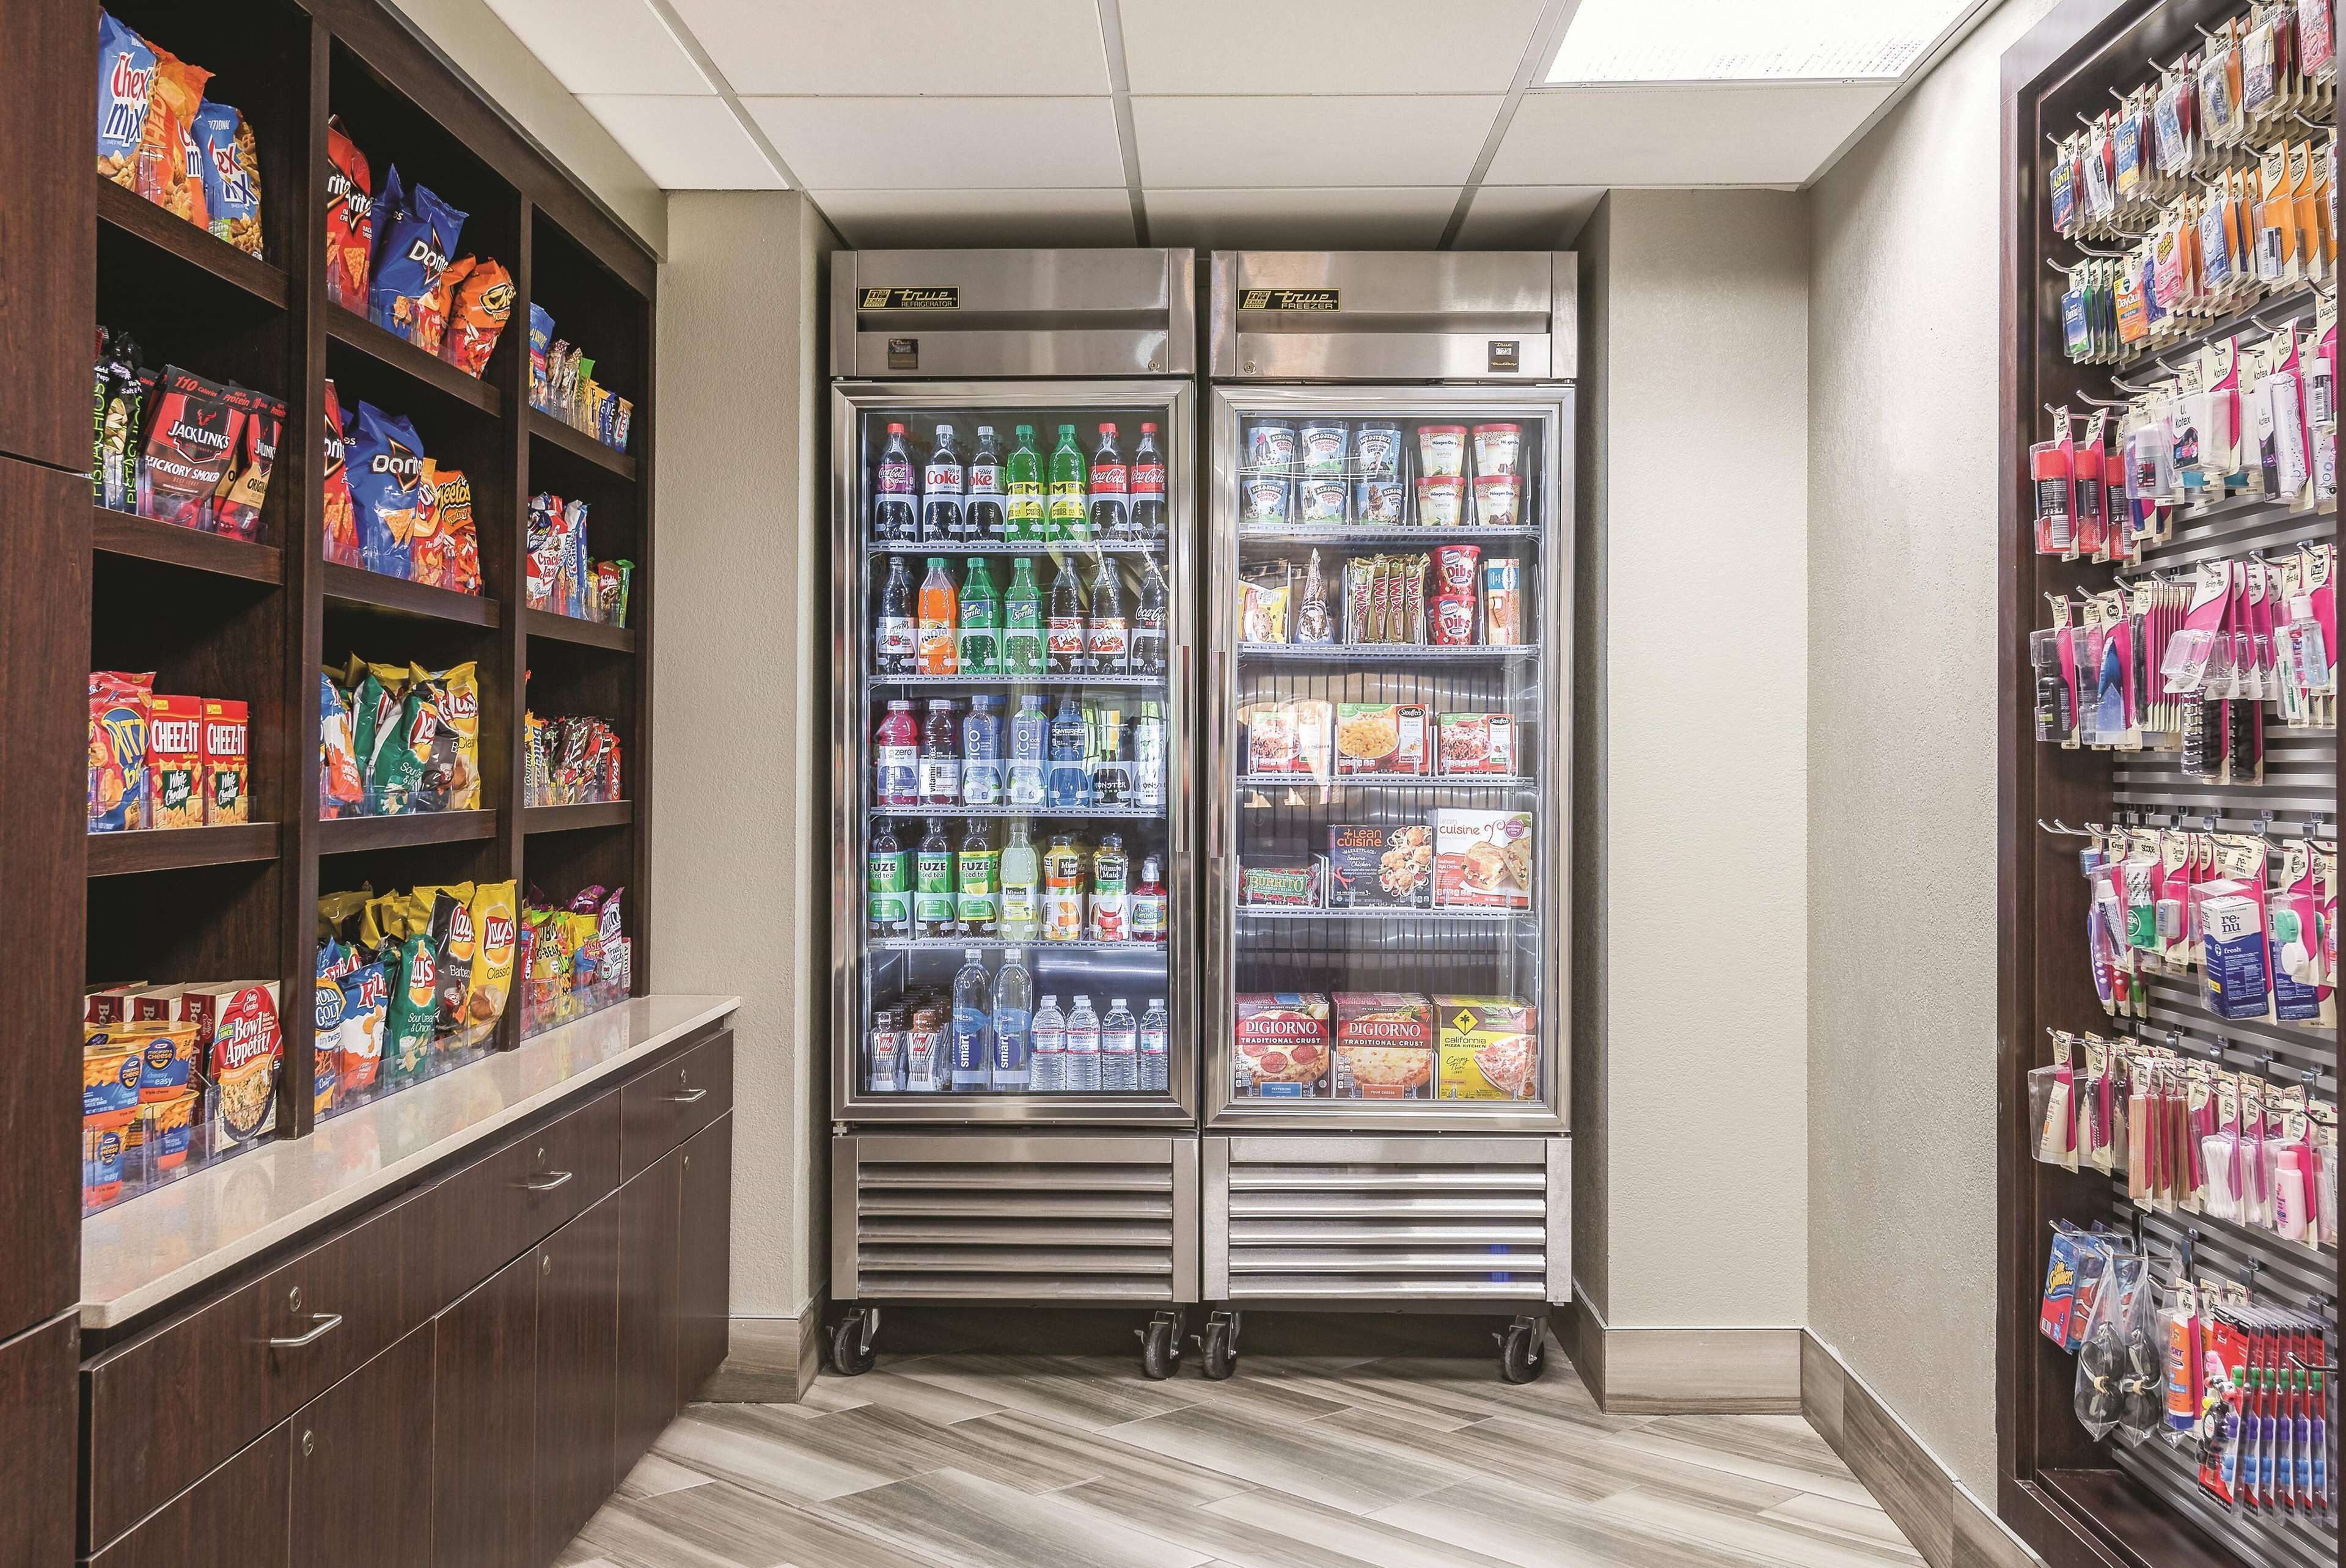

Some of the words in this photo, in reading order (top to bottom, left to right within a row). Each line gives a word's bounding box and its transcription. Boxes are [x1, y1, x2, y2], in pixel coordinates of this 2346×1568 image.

[111, 54, 153, 101] Chex
[104, 101, 145, 144] mix
[2268, 162, 2282, 177] TUMS
[2054, 167, 2070, 189] Advil
[175, 376, 198, 392] 110
[372, 455, 423, 474] Dorito
[927, 471, 960, 485] Coke
[969, 472, 992, 486] oke
[1090, 468, 1125, 485] Coca-Cola
[1446, 564, 1472, 578] Dibs
[1390, 572, 1404, 611] TWIX
[1407, 571, 1420, 612] TWIX
[962, 608, 981, 620] Sprite
[1013, 608, 1033, 621] Sprite
[1444, 615, 1470, 628] Dibs
[152, 719, 200, 753] CHEEZ-IT
[208, 723, 246, 755] CHEEZ-IT
[170, 771, 187, 788] White
[222, 771, 236, 788] White
[1439, 824, 1480, 835] cuisine
[1337, 838, 1382, 847] cuisine
[870, 862, 896, 871] FUZE
[919, 862, 947, 871] FUZE
[961, 862, 989, 871] FUZE
[1249, 876, 1303, 892] BURRITO
[484, 918, 515, 950] Lay's
[486, 967, 510, 980] Classic
[408, 1013, 420, 1022] Sour
[233, 1011, 263, 1043] Bowl
[1245, 1021, 1318, 1034] DIGIORNO
[1348, 1022, 1421, 1038] DIGIORNO
[880, 1038, 893, 1050] illy
[914, 1038, 926, 1050] illy
[155, 1077, 173, 1086] easy
